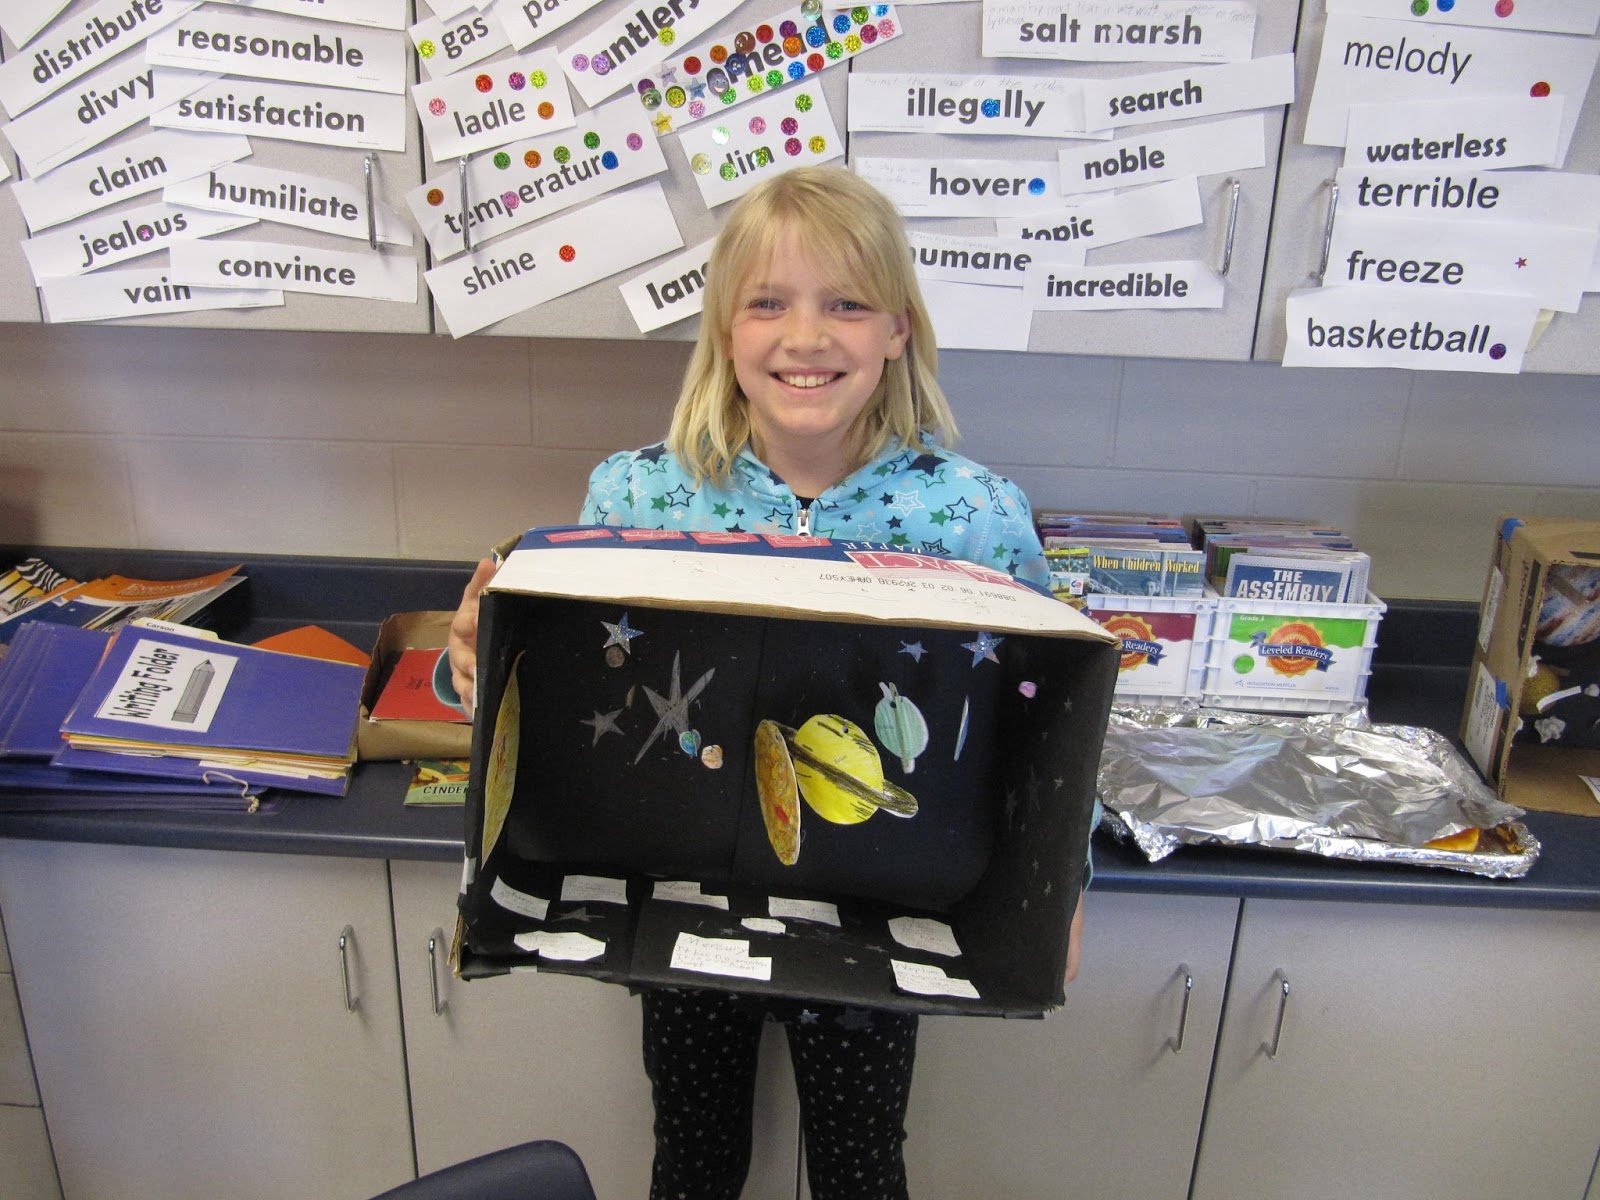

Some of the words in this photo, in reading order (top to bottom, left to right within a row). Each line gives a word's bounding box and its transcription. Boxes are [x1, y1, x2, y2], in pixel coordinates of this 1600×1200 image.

[33, 0, 164, 84] distribute
[441, 16, 489, 60] gas
[1019, 13, 1081, 43] salt
[1094, 15, 1203, 45] marsh
[177, 26, 365, 68] reasonable
[1343, 37, 1472, 85] melody
[77, 69, 155, 125] divvy
[178, 95, 366, 133] satisfaction
[1109, 80, 1203, 117] search
[453, 99, 526, 138] ladle
[1083, 145, 1165, 180] noble
[1366, 133, 1508, 163] waterless
[89, 153, 168, 197] claim
[929, 167, 1026, 197] hover
[1357, 176, 1500, 209] terrible
[208, 172, 359, 222] humiliate
[444, 152, 618, 235] temeratur
[79, 213, 188, 268] jealous
[1021, 216, 1094, 242] topic
[218, 255, 357, 286] convince
[463, 251, 536, 295] shine
[1346, 250, 1464, 286] freeze
[123, 276, 192, 304] vain
[1046, 273, 1189, 299] incredible
[1306, 317, 1491, 354] basketball
[1092, 555, 1120, 570] When
[1121, 556, 1162, 572] Children
[1165, 559, 1200, 574] Worked
[1273, 569, 1304, 582] THE
[1236, 579, 1334, 602] ASSEMBLY
[146, 622, 175, 632] Carson
[1239, 614, 1260, 622] Grade
[131, 647, 180, 682] Folder
[1125, 640, 1159, 655] Readers
[1261, 645, 1293, 655] Leveled
[1295, 646, 1329, 660] Readers
[108, 681, 173, 719] Writing
